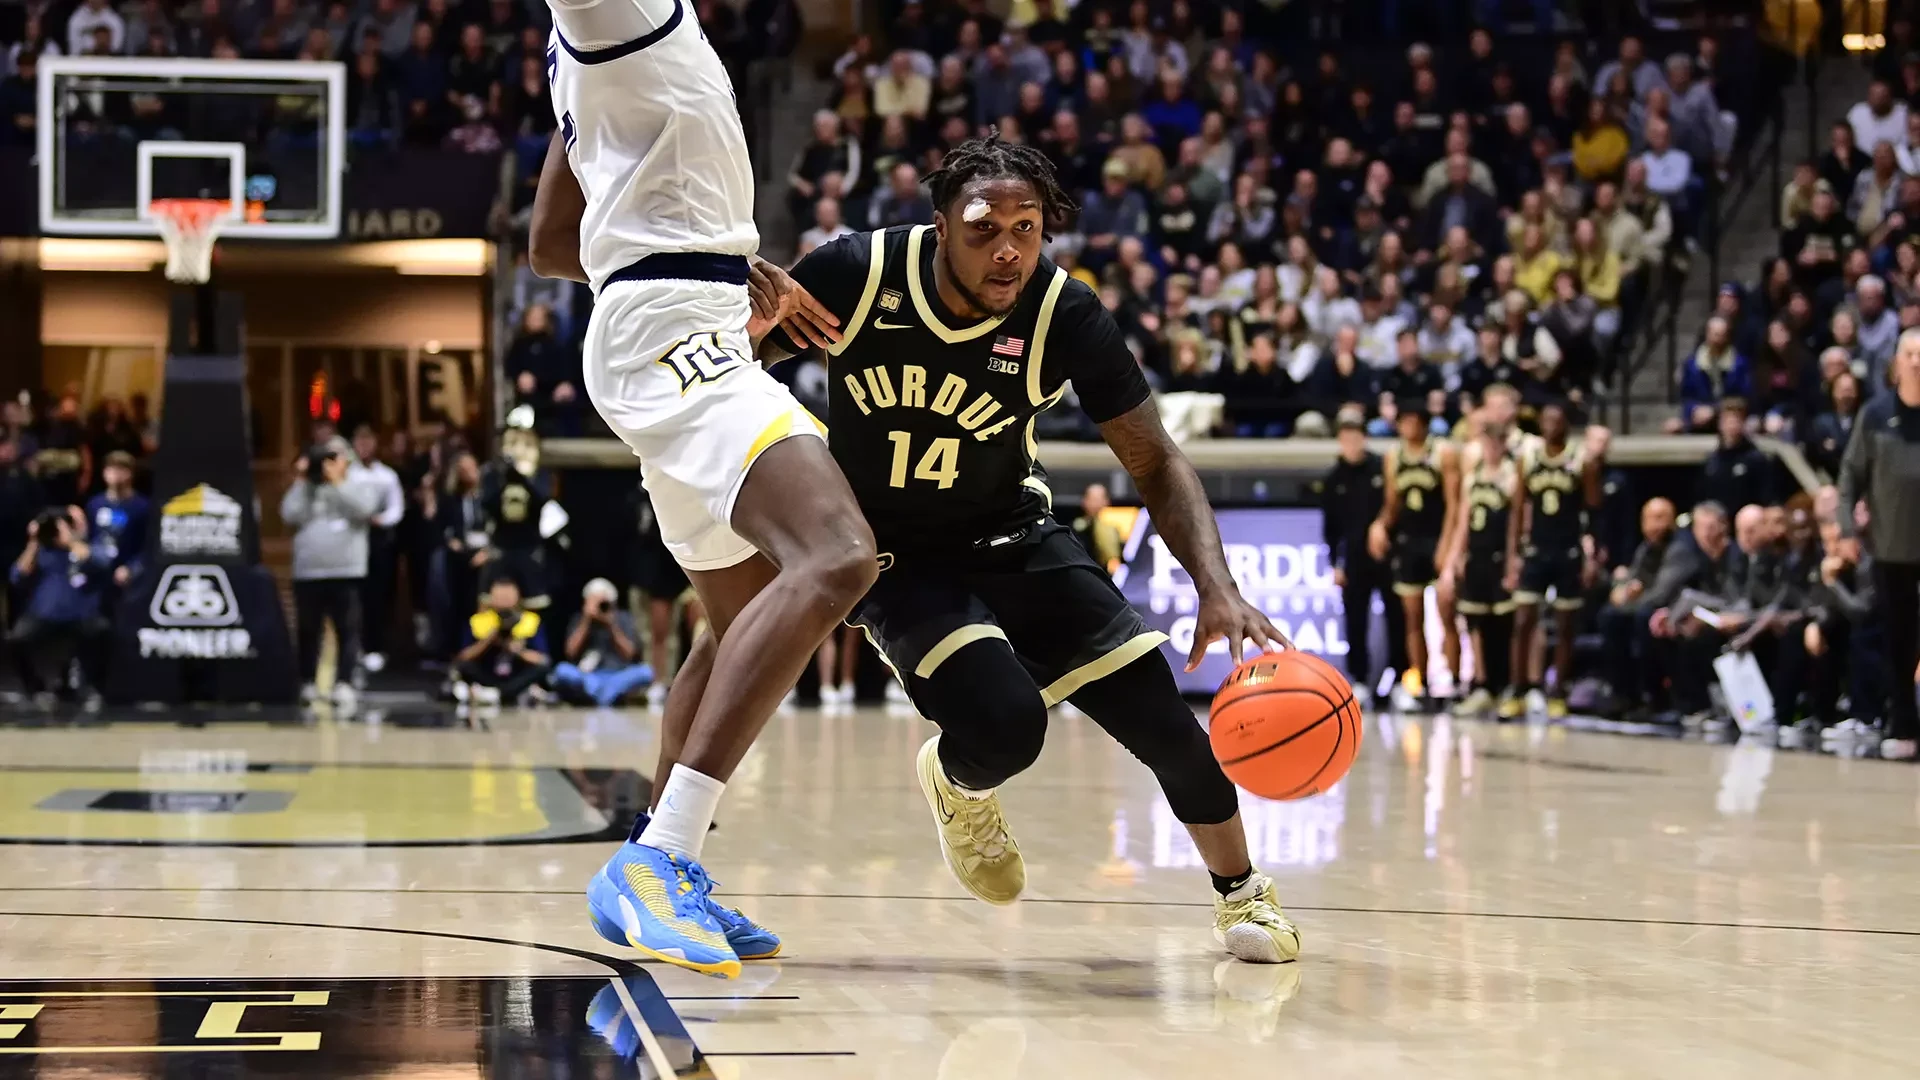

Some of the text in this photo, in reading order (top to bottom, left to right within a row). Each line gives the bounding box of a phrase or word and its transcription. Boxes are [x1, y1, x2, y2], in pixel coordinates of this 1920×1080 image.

[844, 364, 1018, 442] PURDUE
[888, 430, 961, 490] 14
[1148, 534, 1340, 590] PRDU
